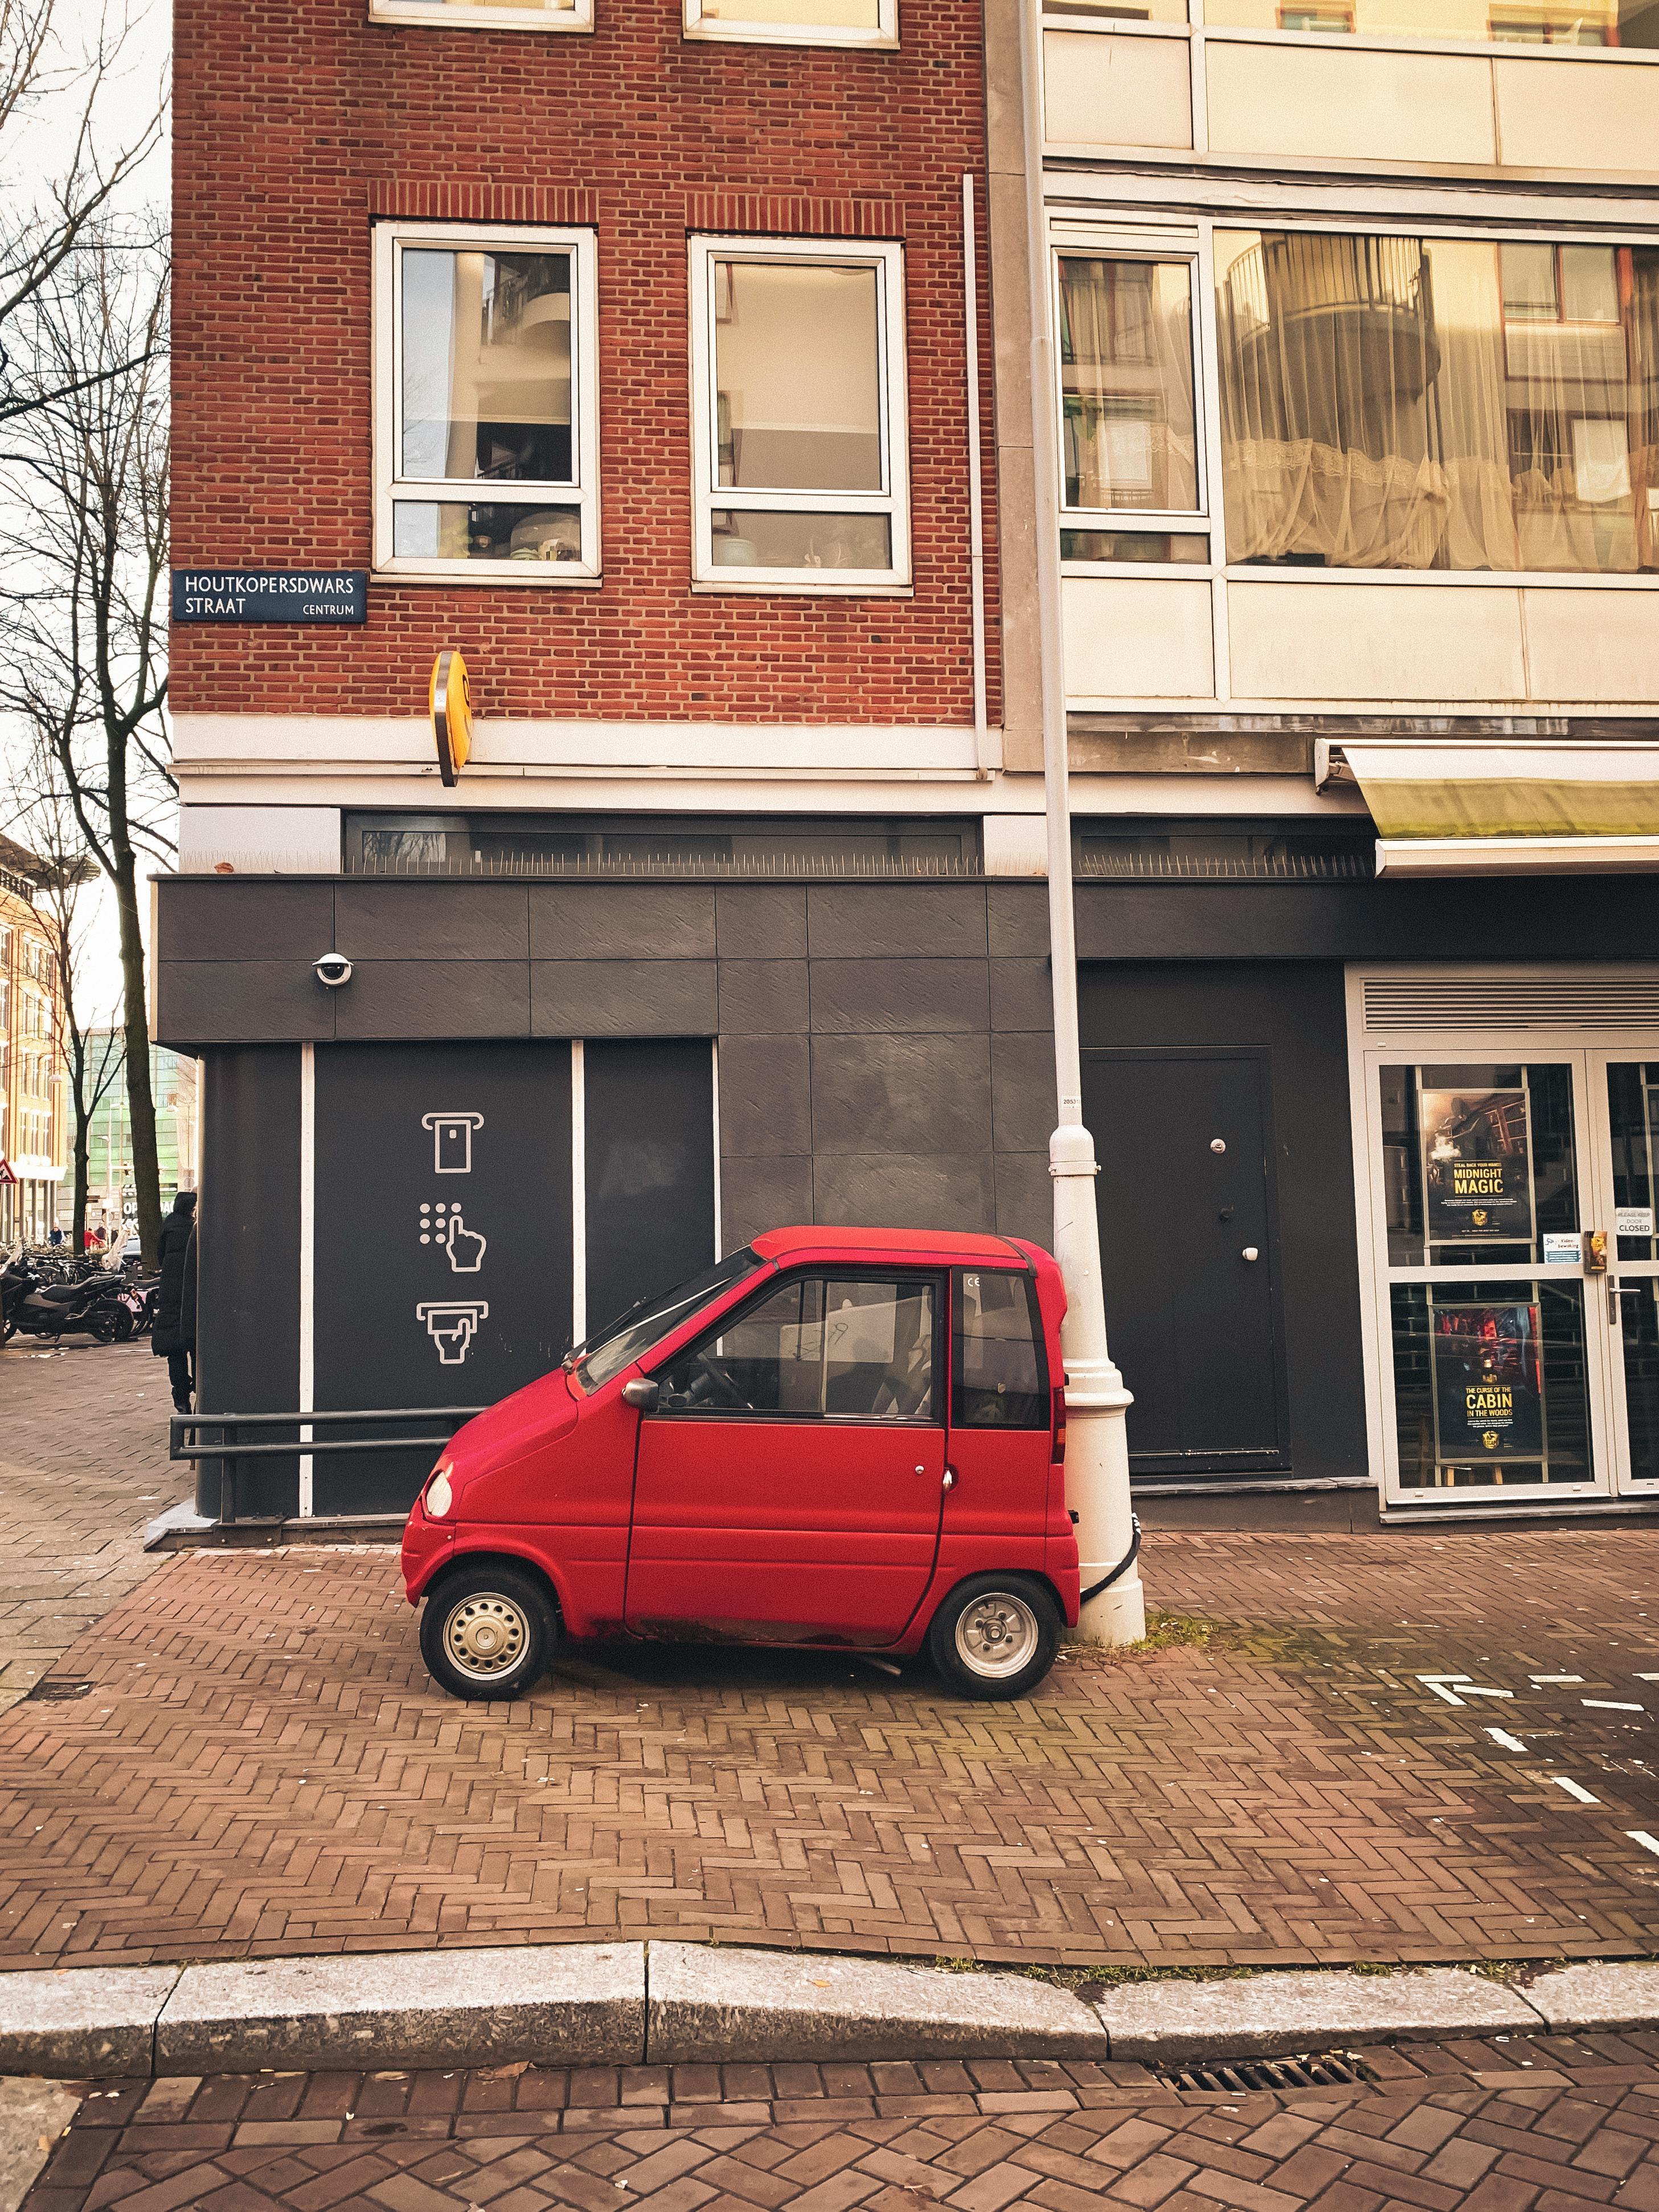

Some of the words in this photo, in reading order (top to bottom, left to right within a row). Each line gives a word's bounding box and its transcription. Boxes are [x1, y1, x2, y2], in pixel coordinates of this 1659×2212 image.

[185, 576, 354, 593] HOUTKOPERSDWARS
[185, 597, 246, 614] STRAAT
[302, 604, 354, 615] CENTRUM
[1453, 1168, 1502, 1179] MIDNIGHT
[1455, 1179, 1504, 1194] MAGIC
[967, 1277, 980, 1287] CE
[1467, 1394, 1512, 1409] CABIN
